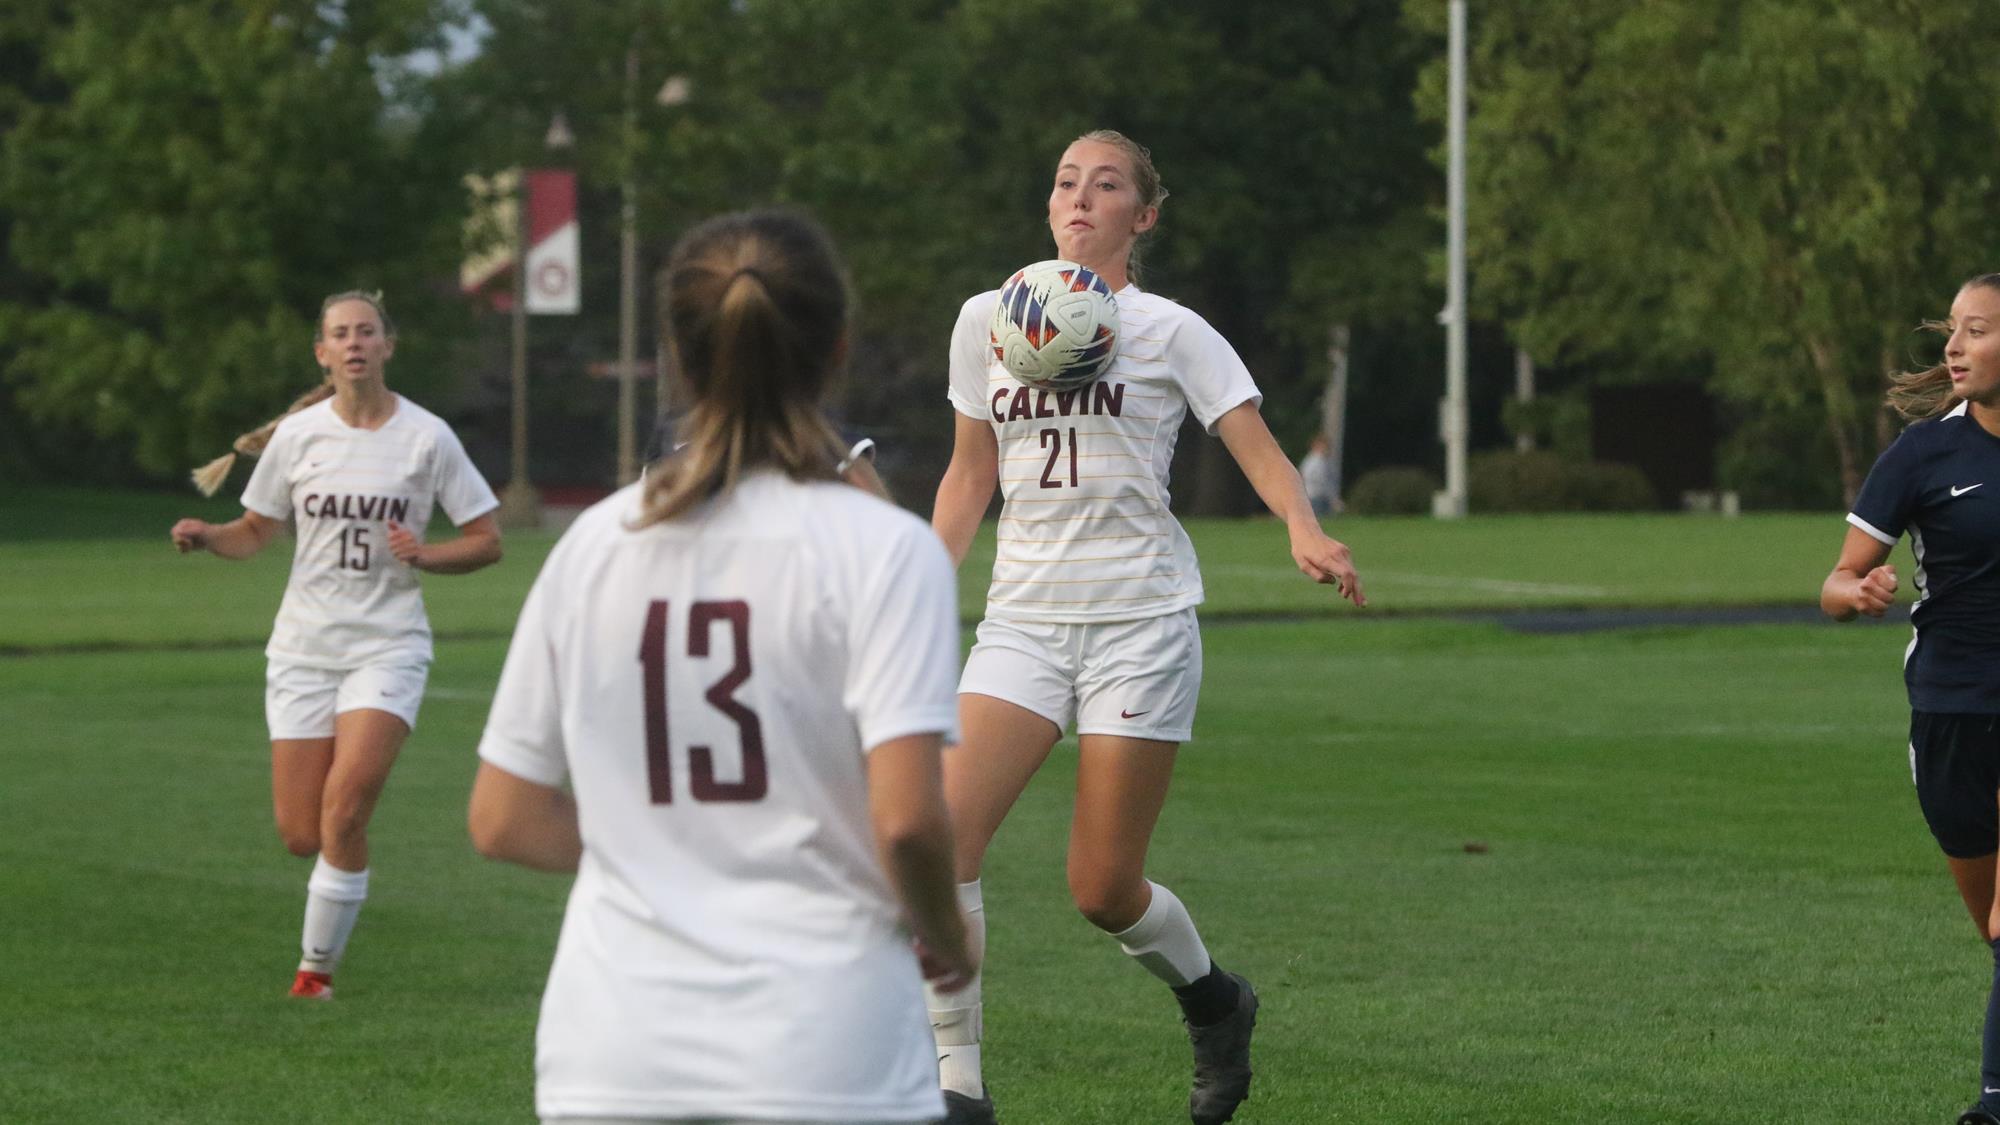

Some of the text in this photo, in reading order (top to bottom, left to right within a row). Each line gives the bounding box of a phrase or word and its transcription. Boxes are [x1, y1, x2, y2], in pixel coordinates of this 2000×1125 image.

[992, 381, 1125, 423] CALVIN
[1040, 427, 1078, 488] 21
[304, 494, 409, 522] CALVIN
[338, 527, 370, 571] 15
[638, 599, 768, 805] 13
